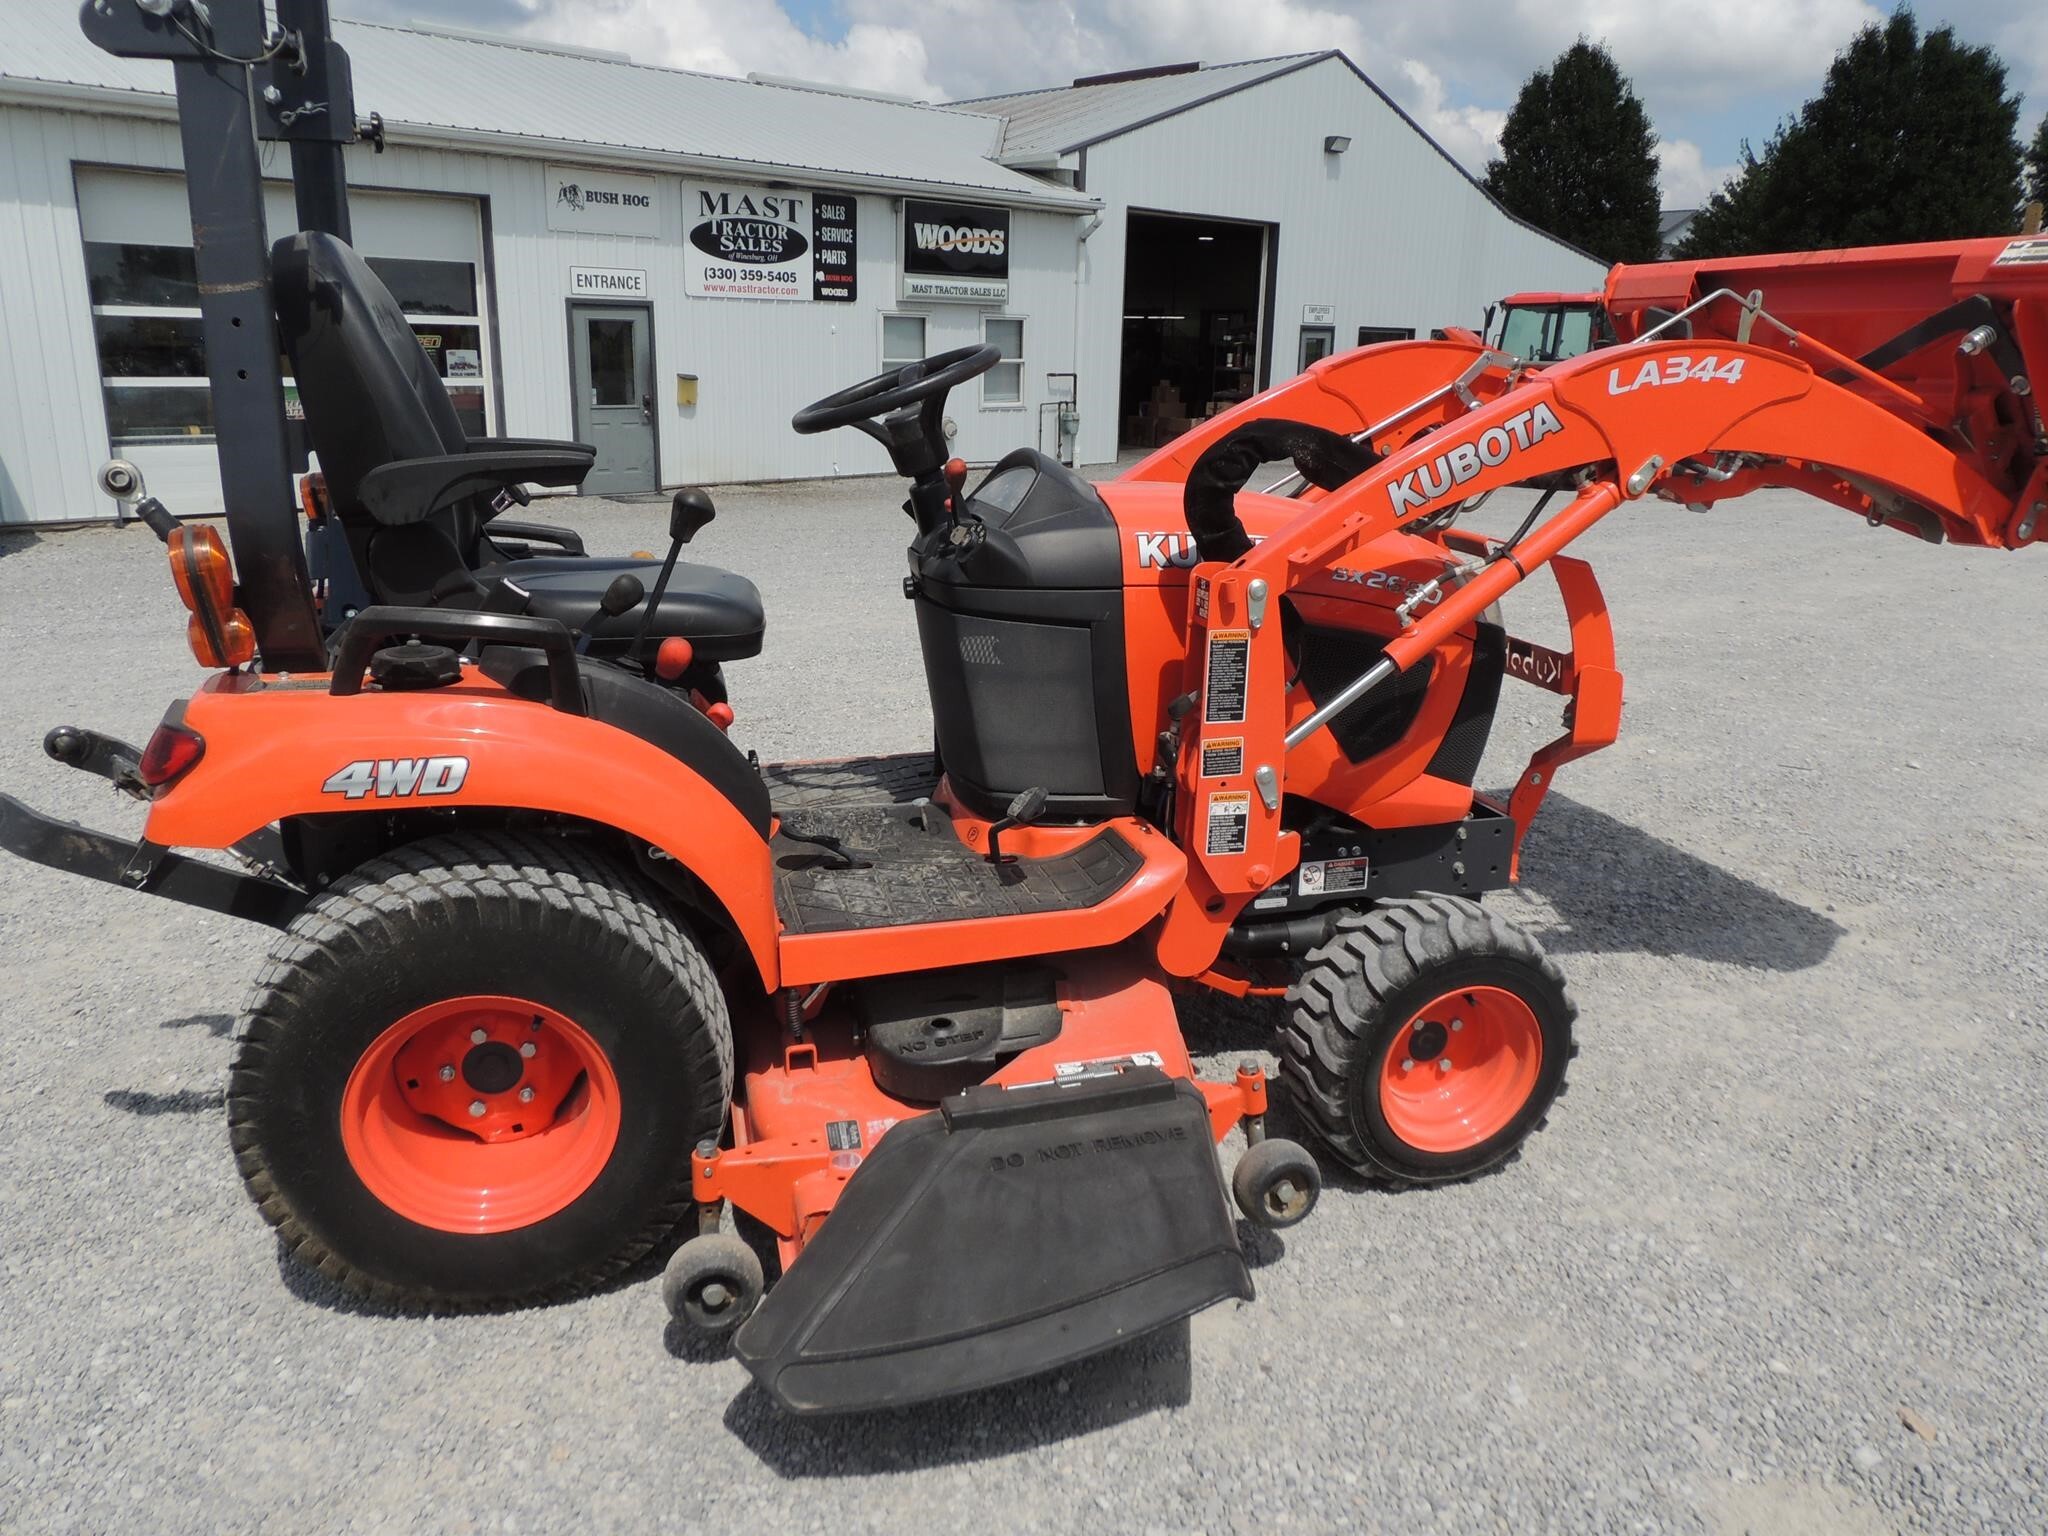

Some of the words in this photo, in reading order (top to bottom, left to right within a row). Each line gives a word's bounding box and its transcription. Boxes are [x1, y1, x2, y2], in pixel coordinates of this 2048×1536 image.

[585, 190, 619, 205] BUSH
[622, 194, 650, 207] HOG
[698, 190, 803, 224] MAST
[821, 204, 846, 221] SALES
[708, 217, 789, 240] TRACTOR
[821, 226, 853, 243] SERVICE
[720, 235, 783, 253] SALES
[913, 222, 1005, 256] WOODS
[767, 254, 778, 262] OH
[821, 249, 847, 265] PARTS
[576, 273, 641, 290] ENTRANCE
[704, 267, 737, 282] (330)
[703, 283, 799, 296] www.masttractor.com
[820, 287, 848, 297] WOODS
[911, 284, 933, 294] MAST
[935, 285, 969, 296] TRACTOR
[969, 287, 992, 297] SALES
[993, 288, 1006, 298] LLC
[417, 337, 439, 347] PEN
[1607, 355, 1746, 396] LA344
[1385, 400, 1565, 518] KUBOTA
[320, 755, 470, 800] 4WD
[898, 1041, 927, 1055] NO
[934, 1029, 985, 1047] STEP
[990, 1152, 1025, 1172] DO
[1038, 1141, 1084, 1163] NOT
[1091, 1126, 1189, 1153] REMOVE
